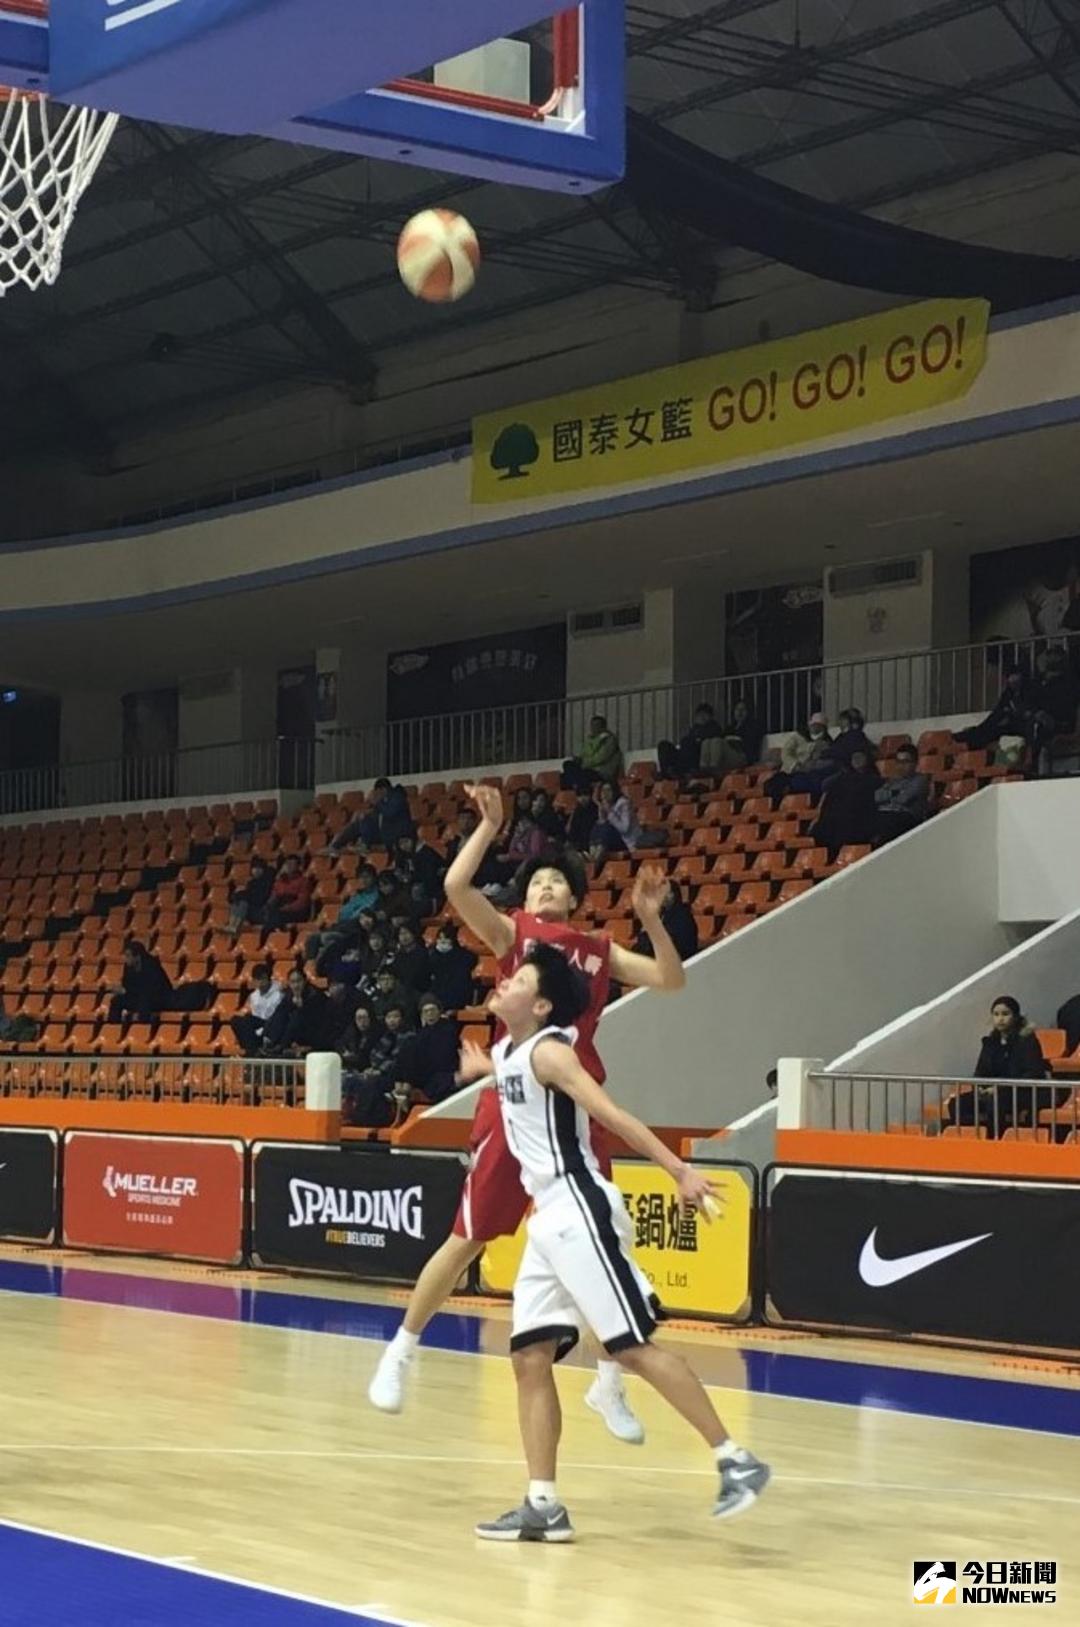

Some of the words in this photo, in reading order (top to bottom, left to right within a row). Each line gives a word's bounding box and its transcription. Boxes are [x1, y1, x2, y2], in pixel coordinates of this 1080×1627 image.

[552, 396, 693, 463] 國泰女籃
[708, 370, 777, 431] GO!
[792, 344, 867, 410] GO!
[884, 316, 967, 385] GO!
[115, 1172, 197, 1196] MUELLER
[288, 1177, 423, 1239] SPALDING
[623, 1193, 698, 1252] 鍋爐
